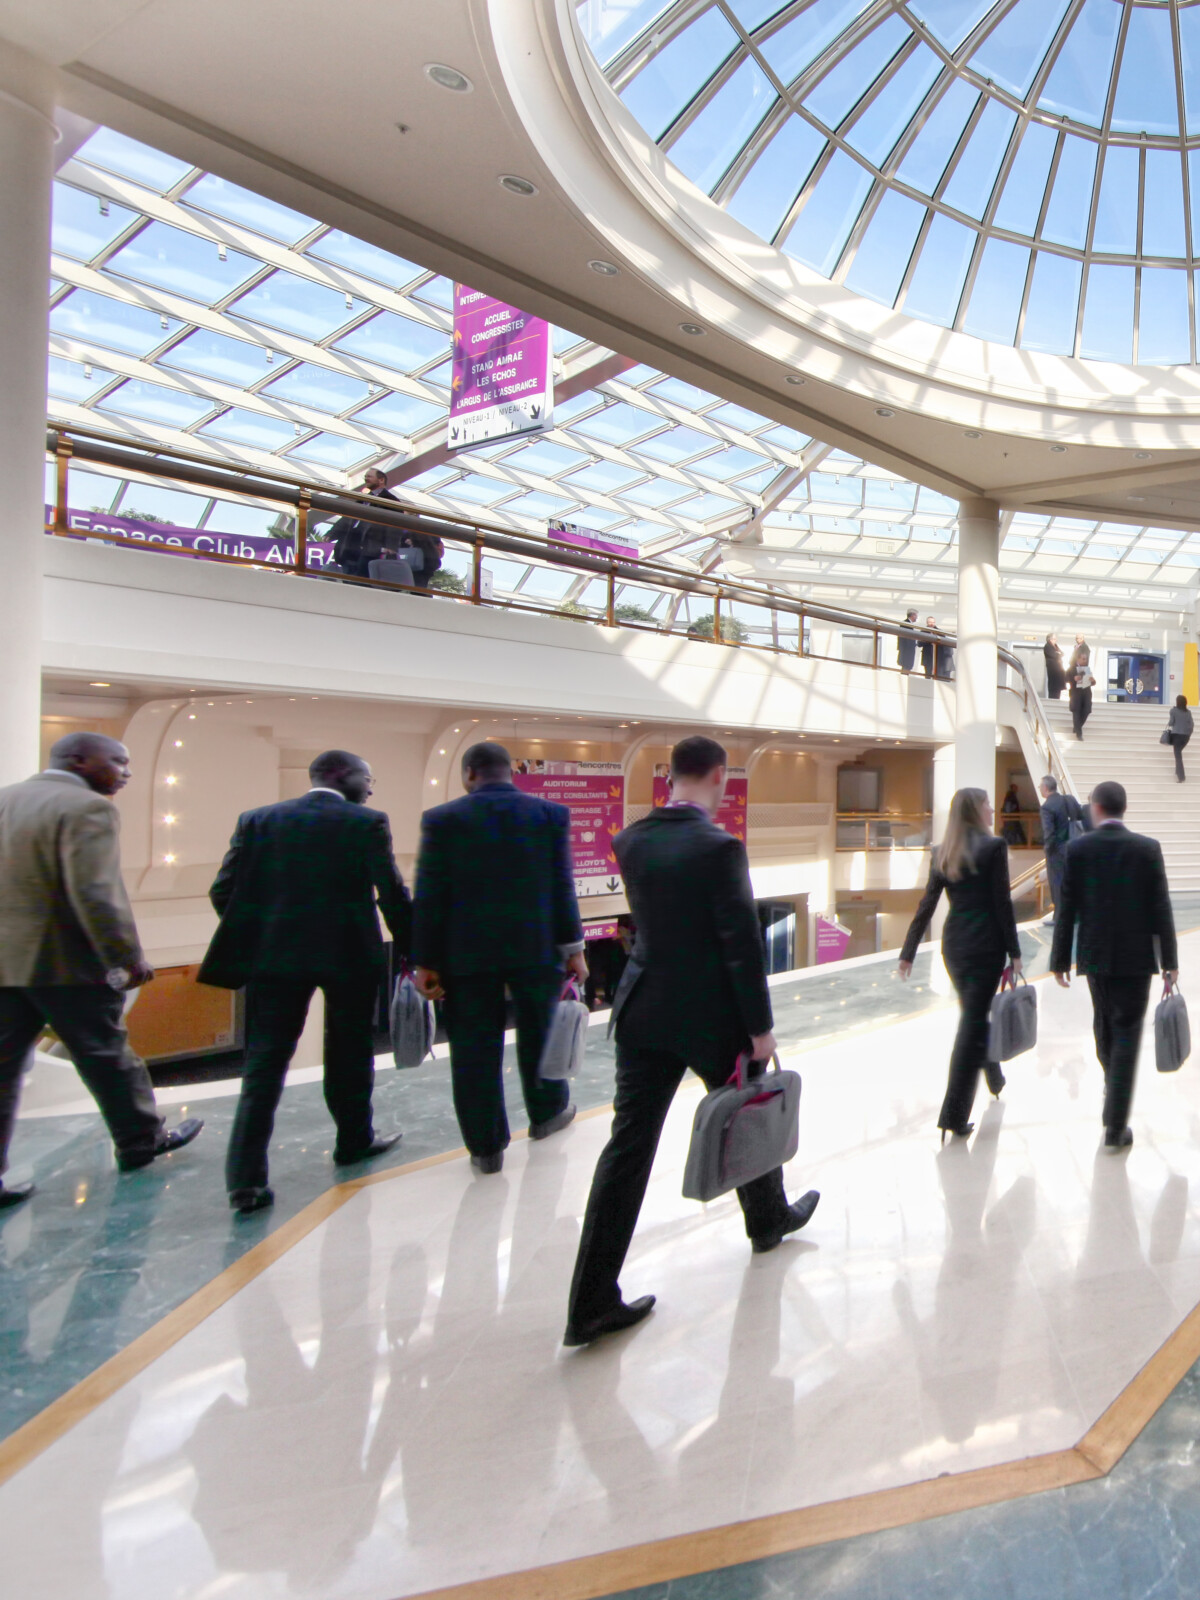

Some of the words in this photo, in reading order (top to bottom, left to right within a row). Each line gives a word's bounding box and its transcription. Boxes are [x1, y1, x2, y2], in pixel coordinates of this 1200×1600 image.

[460, 289, 489, 306] INTERVE
[484, 310, 511, 327] ACCUEIL
[471, 318, 525, 344] CONGRESSISTES
[471, 360, 494, 374] STAND
[496, 351, 523, 367] AMRAE
[476, 375, 490, 388] LES
[492, 368, 517, 383] ECHOS
[483, 390, 492, 401] DE
[193, 535, 256, 560] Club
[577, 761, 622, 769] Rencontres
[584, 928, 603, 937] AIRE
